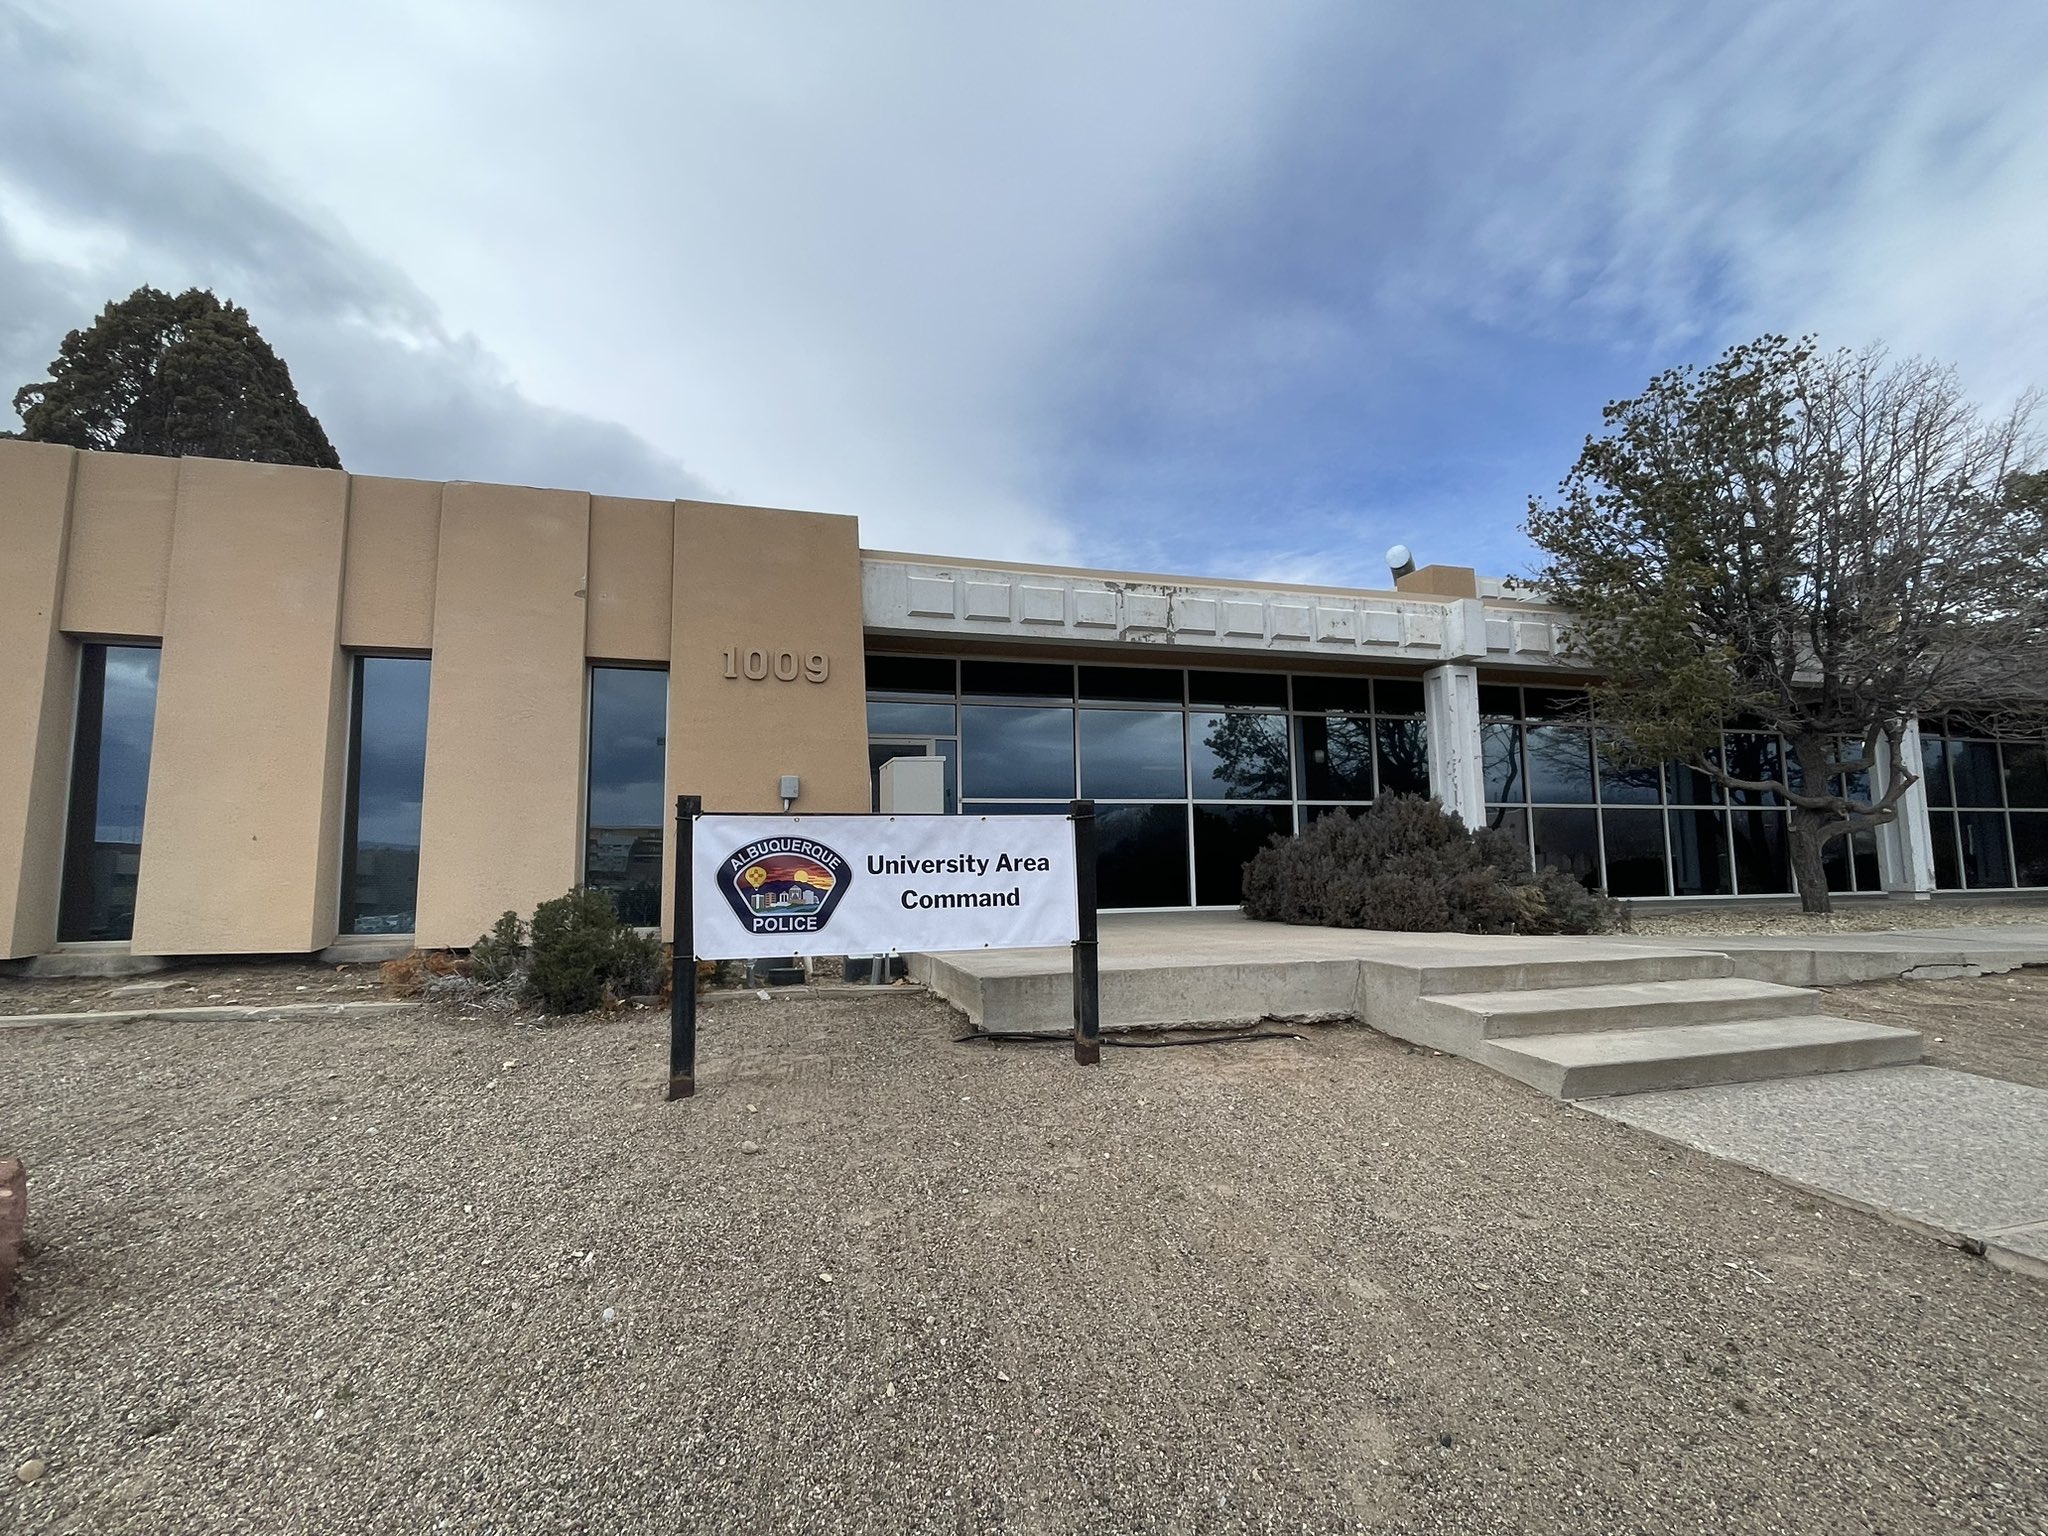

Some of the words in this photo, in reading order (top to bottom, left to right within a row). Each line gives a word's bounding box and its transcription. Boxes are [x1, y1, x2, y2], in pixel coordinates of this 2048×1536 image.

[723, 646, 830, 684] 1009
[729, 839, 842, 871] ALBUQUERQUE
[867, 854, 988, 876] University
[995, 853, 1050, 872] Area
[901, 888, 1020, 909] Command
[753, 916, 818, 932] POLICE
